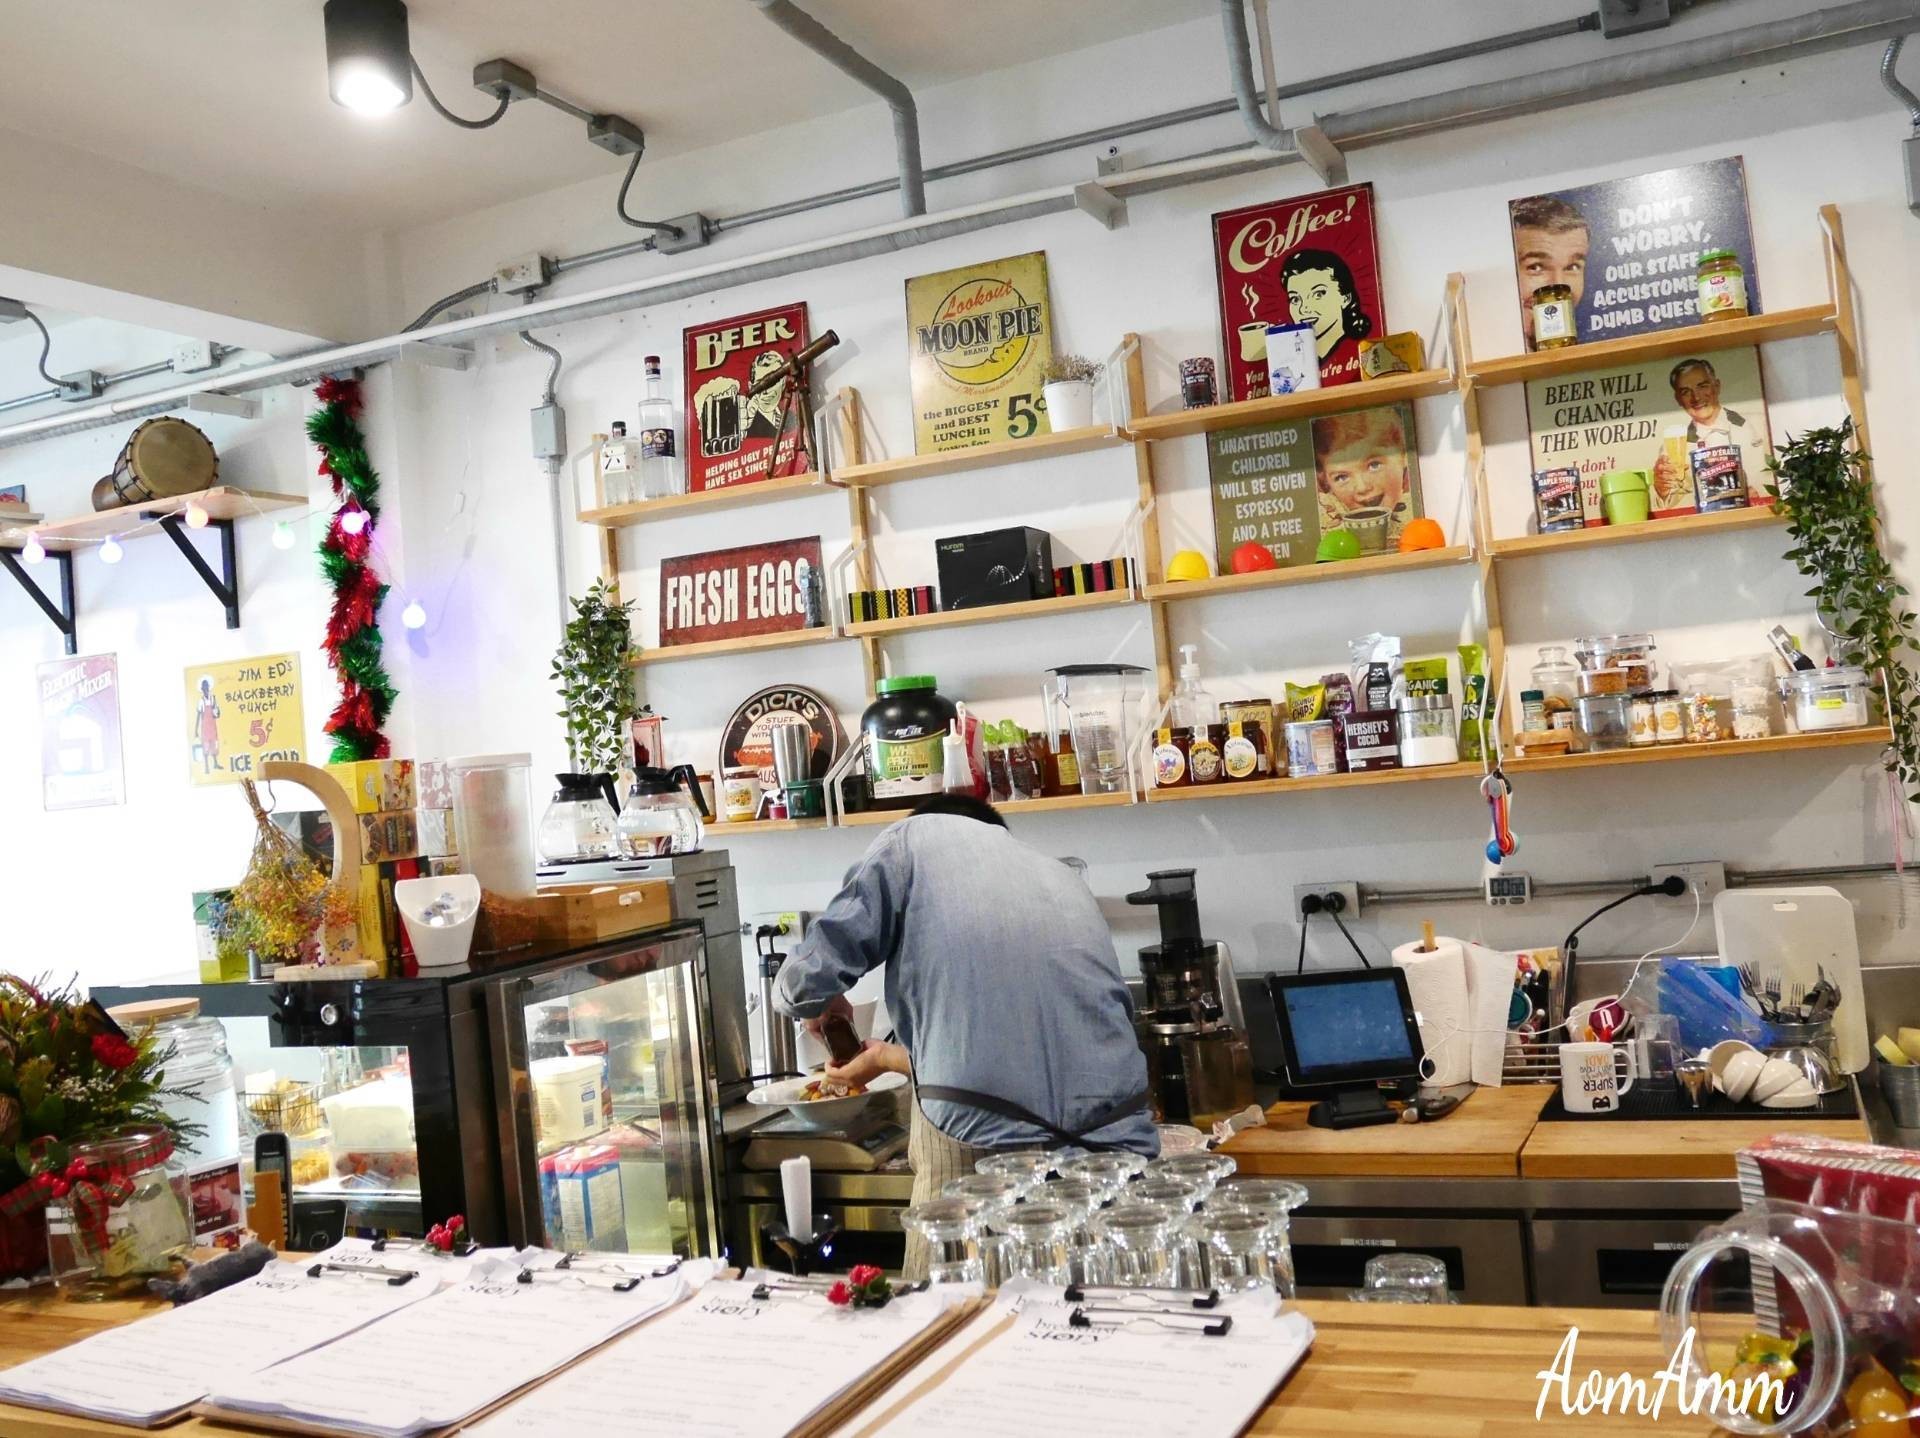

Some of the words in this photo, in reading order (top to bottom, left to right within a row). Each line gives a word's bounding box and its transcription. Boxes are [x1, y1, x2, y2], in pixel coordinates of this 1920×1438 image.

[1618, 196, 1693, 229] DON'T
[1229, 195, 1356, 274] Coffee!
[1611, 221, 1712, 256] WORRY,
[1606, 260, 1644, 283] OUR
[1647, 251, 1699, 276] STAFF
[942, 278, 1013, 320] Lookout
[1594, 274, 1698, 308] ACCUSTOME
[1590, 307, 1644, 332] DUMB
[1648, 298, 1702, 324] QUEST
[917, 312, 993, 354] MOON
[997, 303, 1042, 341] PIE
[694, 317, 796, 371] BEER
[963, 346, 989, 357] BRAND
[1246, 370, 1264, 385] You
[1545, 380, 1595, 406] BEER
[1600, 372, 1648, 396] WILL
[1246, 384, 1271, 400] slee
[923, 410, 942, 421] the
[944, 399, 1000, 419] BIGGEST
[934, 418, 956, 431] and
[958, 413, 991, 427] BEST
[1554, 398, 1634, 428] CHANGE
[933, 428, 976, 443] LUNCH
[978, 427, 991, 437] in
[1219, 428, 1298, 456] UNATTENDED
[1541, 430, 1579, 454] THE
[1583, 419, 1657, 446] WORLD!
[705, 458, 739, 478] HELPING
[741, 449, 760, 466] UGLY
[763, 438, 794, 457] PEPLE
[1231, 453, 1290, 476] CHILDREN
[1581, 456, 1616, 474] don't
[705, 475, 726, 490] HAVE
[728, 468, 743, 483] SEX
[745, 459, 768, 476] SINCE
[1220, 483, 1248, 500] WILL
[1251, 479, 1267, 495] BE
[1269, 472, 1307, 493] GIVEN
[1235, 497, 1295, 520] ESPRESSO
[1232, 525, 1257, 543] AND
[1260, 523, 1270, 539] A
[1273, 518, 1303, 536] FREE
[666, 567, 739, 630] FRESH
[747, 557, 810, 620] EGGS
[237, 669, 262, 683] JIM
[1407, 679, 1439, 691] GANIC
[225, 684, 295, 703] BLACKBERRY
[239, 699, 278, 714] PUNCH
[745, 692, 820, 723] DICK'S
[766, 716, 795, 724] STUFF
[1348, 720, 1389, 736] HERSHEY'S
[1357, 734, 1380, 746] COCOA
[230, 754, 251, 773] ICE
